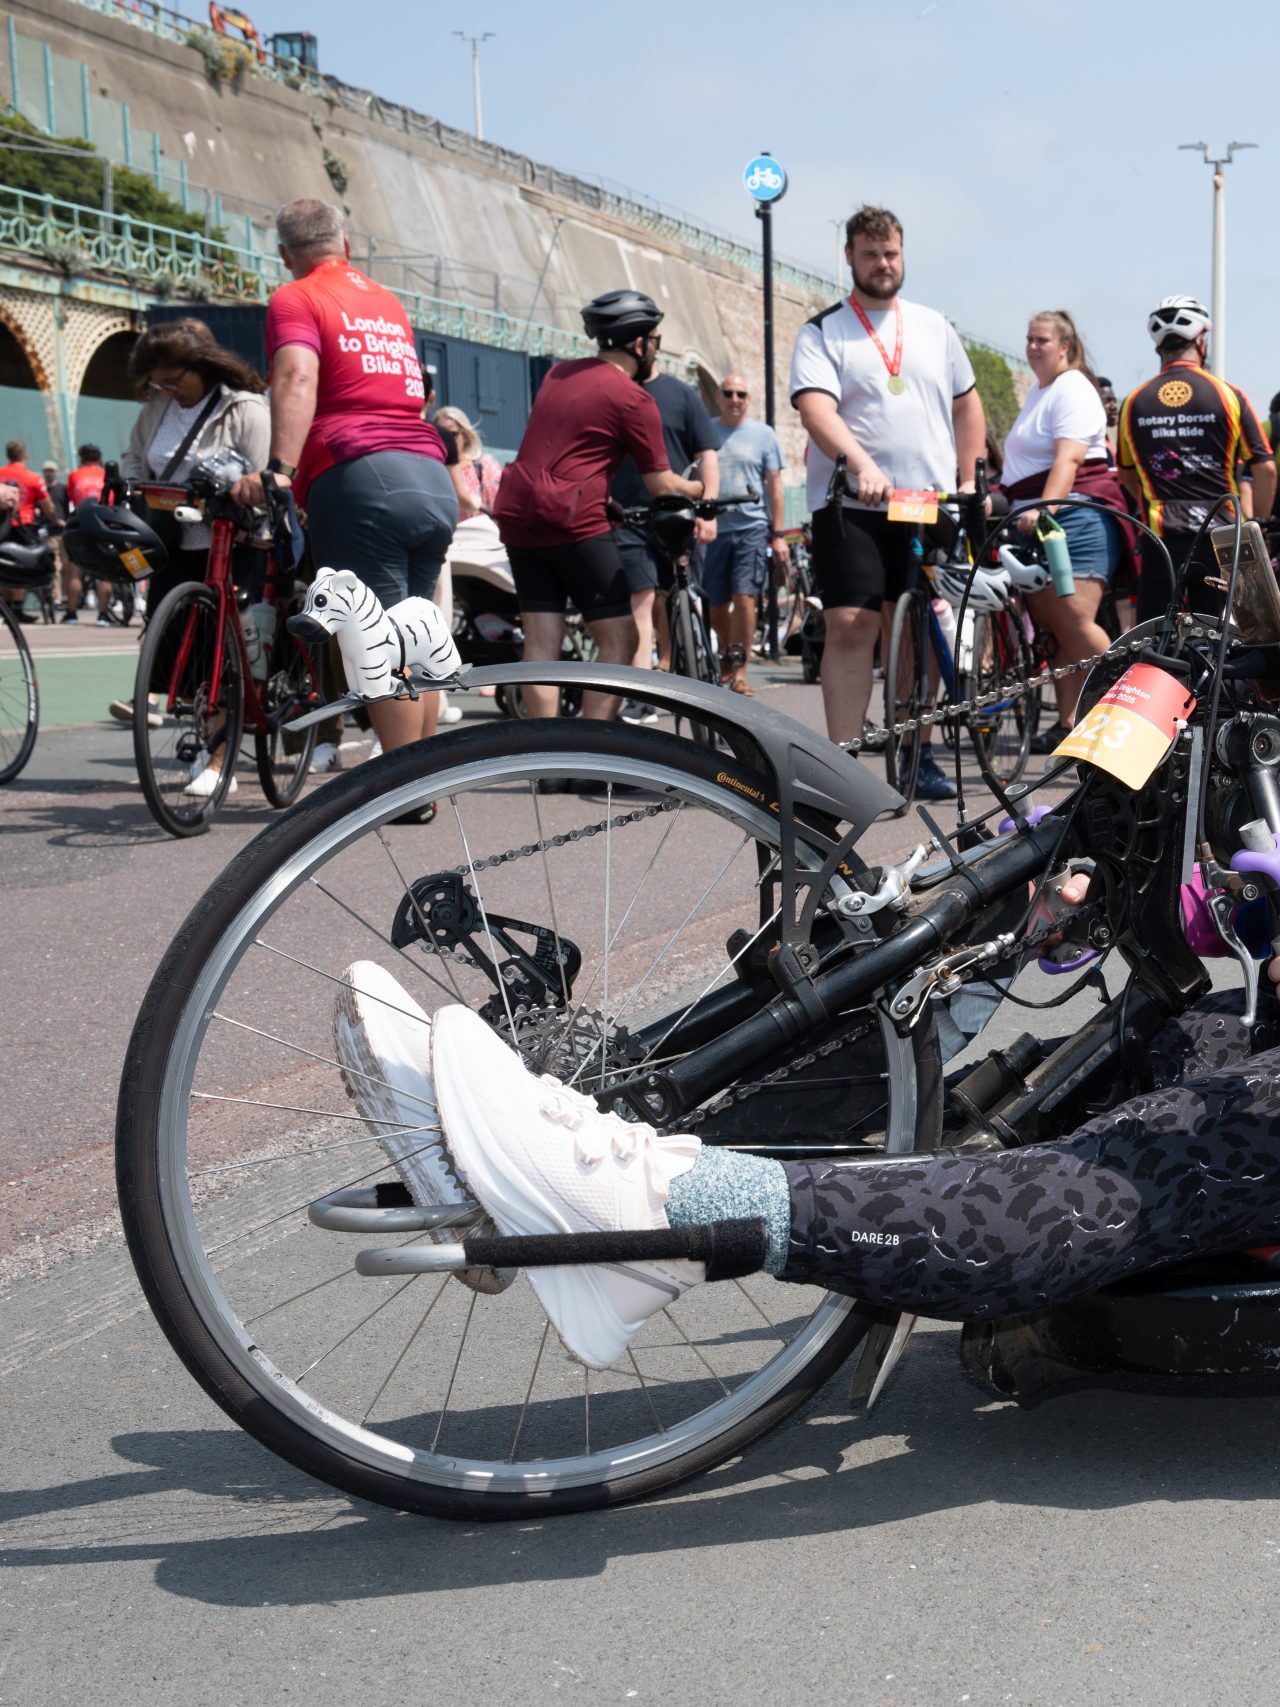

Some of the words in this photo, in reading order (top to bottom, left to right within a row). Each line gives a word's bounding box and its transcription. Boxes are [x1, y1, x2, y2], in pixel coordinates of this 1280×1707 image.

[341, 311, 406, 338] London
[338, 333, 362, 353] to
[361, 354, 402, 375] Bike
[1137, 415, 1176, 427] Rotary
[1177, 413, 1216, 423] Dorset
[1151, 428, 1177, 438] Bike
[1178, 426, 1205, 437] Ride
[1116, 693, 1137, 705] 2025
[1119, 683, 1151, 700] Brighton
[716, 772, 762, 800] Continental
[851, 1230, 900, 1246] DARE2B
